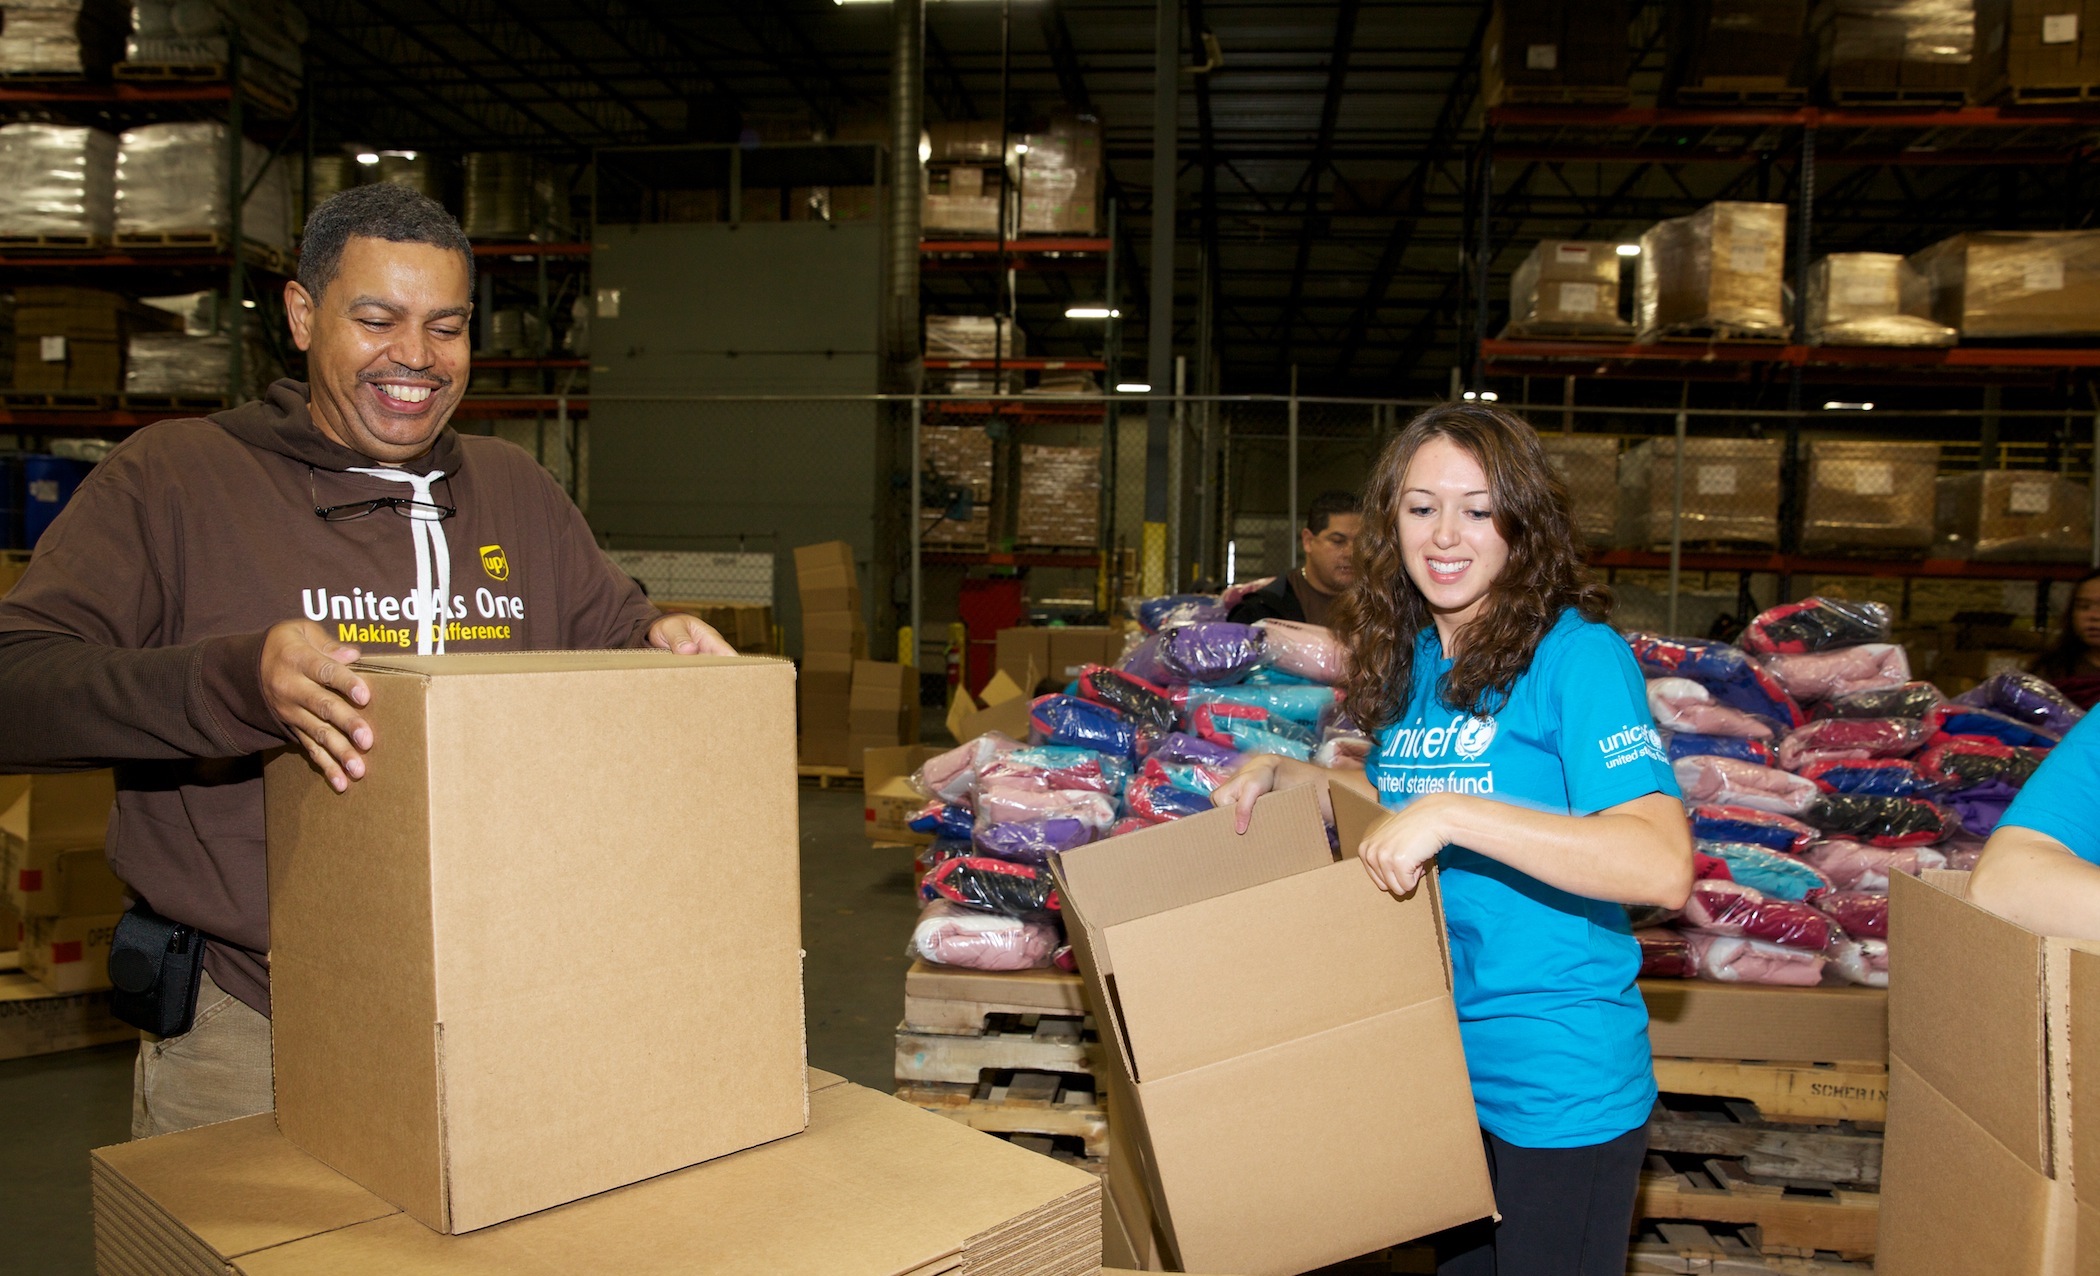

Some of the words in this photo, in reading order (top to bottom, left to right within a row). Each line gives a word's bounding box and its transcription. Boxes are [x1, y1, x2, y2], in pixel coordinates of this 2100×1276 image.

[302, 587, 419, 621] United
[432, 589, 468, 621] As
[475, 587, 525, 620] One
[338, 623, 412, 648] Making
[432, 621, 511, 642] Difference
[1381, 715, 1464, 759] unicef
[1605, 749, 1638, 769] united
[1377, 771, 1406, 793] nited
[1406, 775, 1444, 794] states
[1447, 770, 1494, 794] fund
